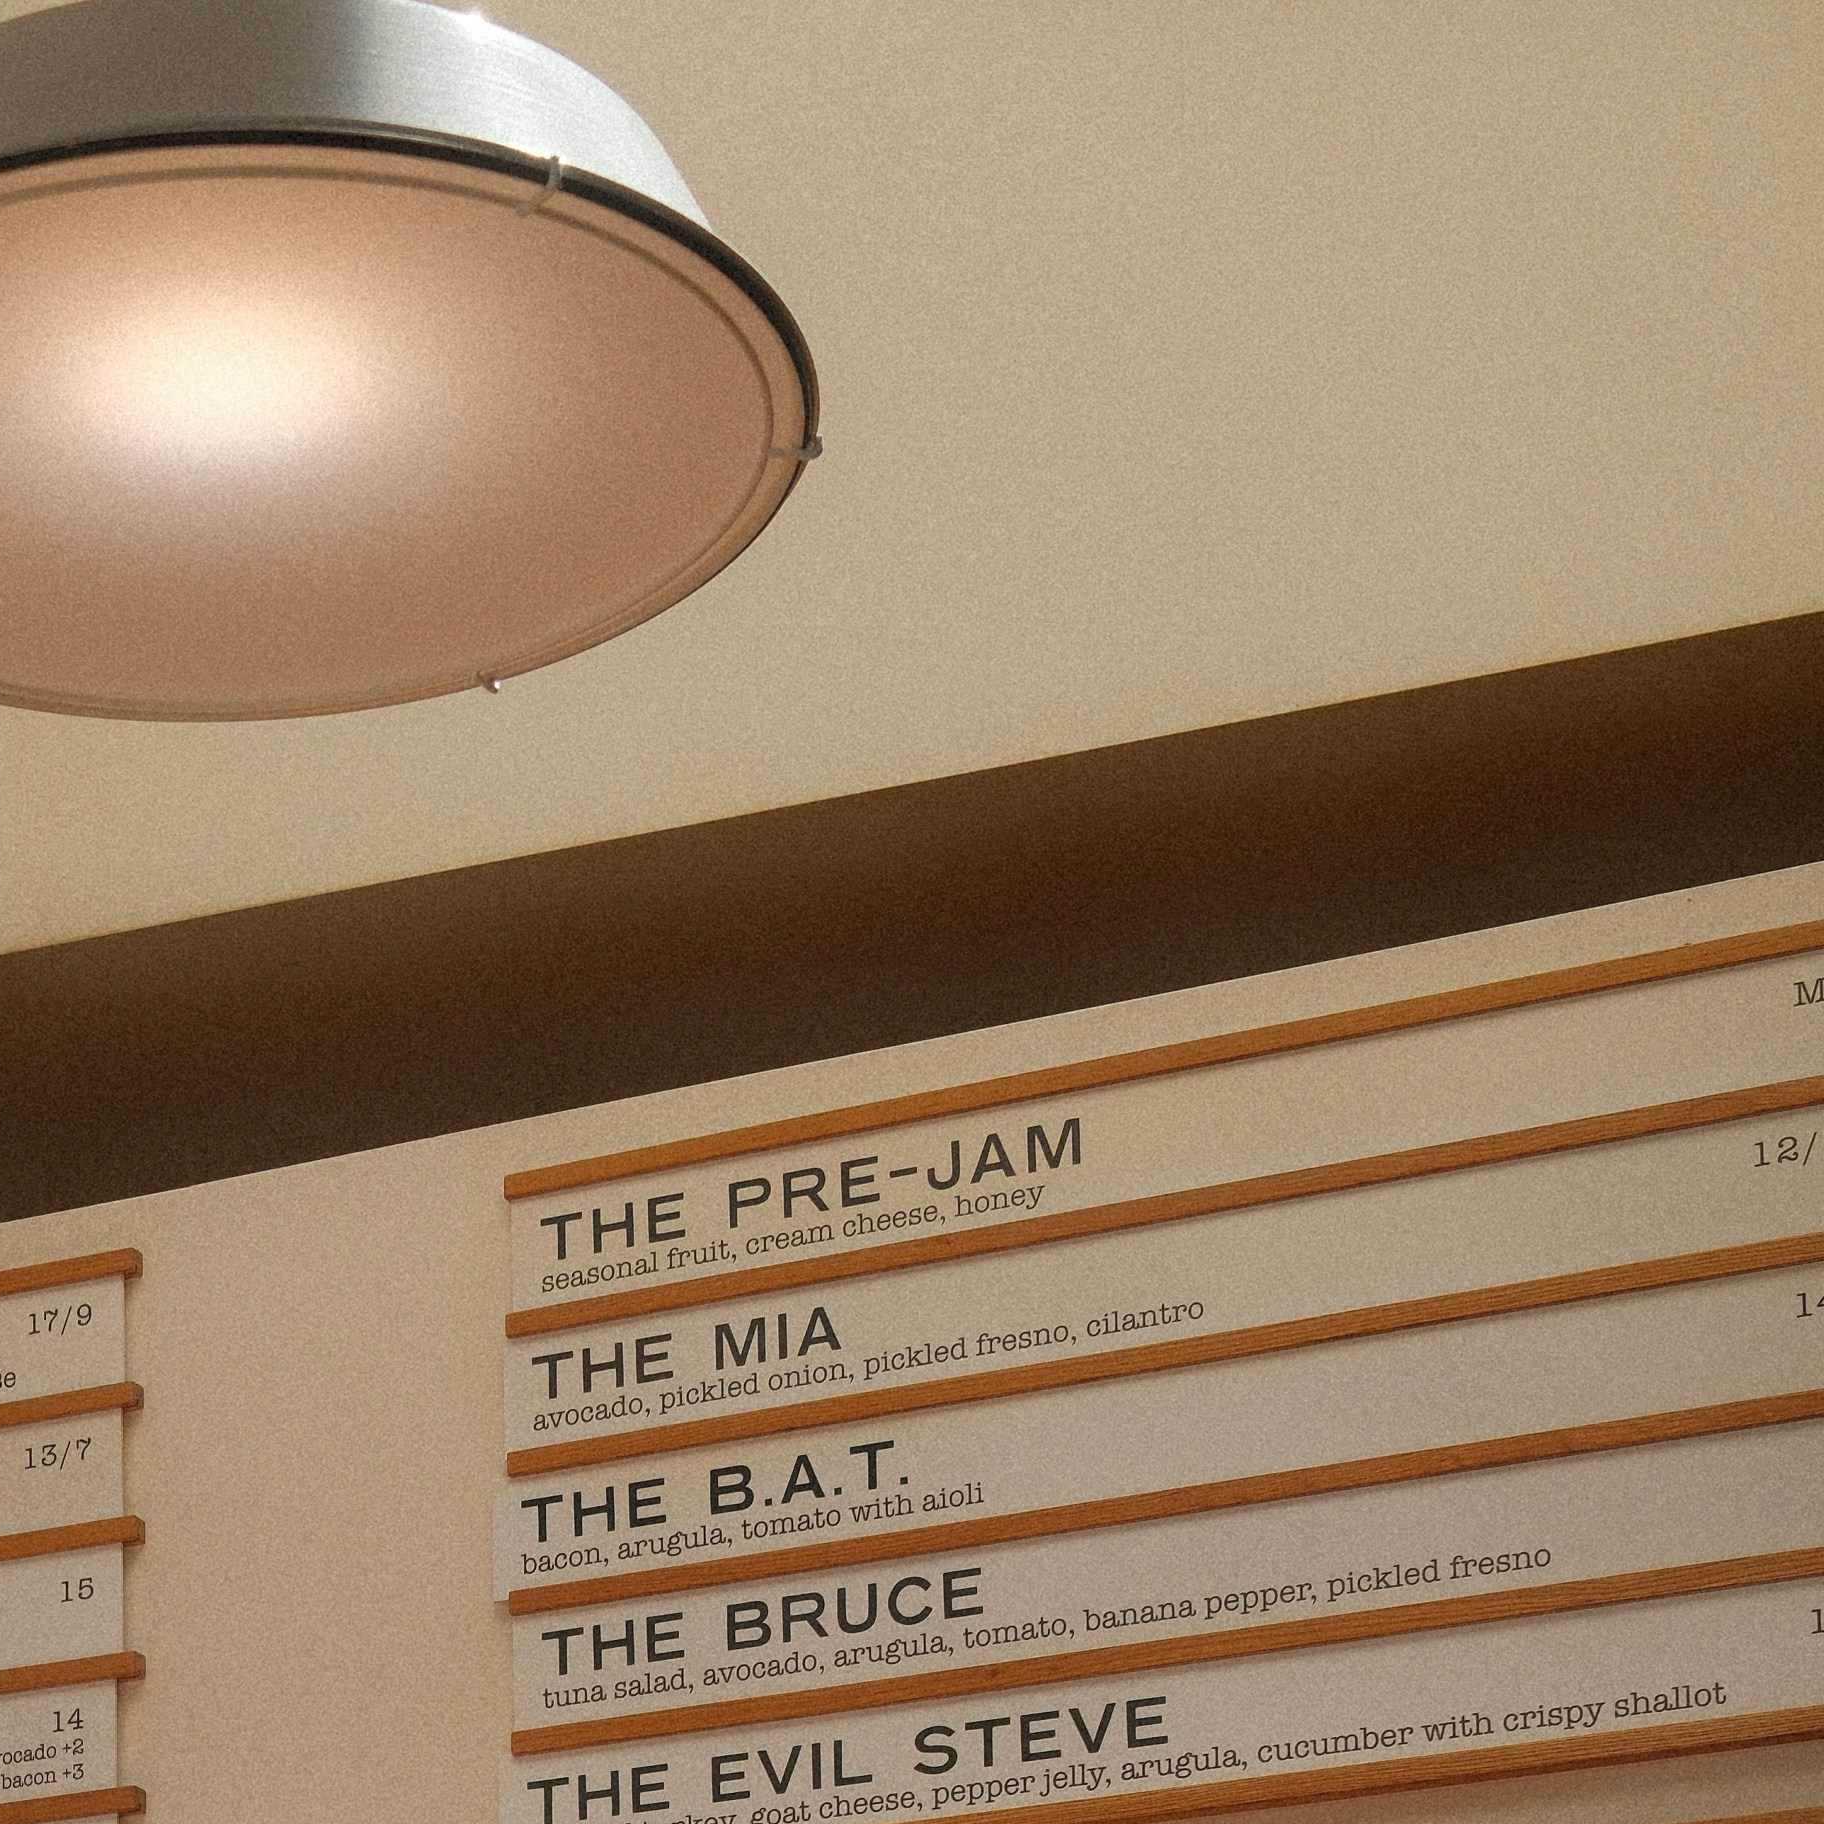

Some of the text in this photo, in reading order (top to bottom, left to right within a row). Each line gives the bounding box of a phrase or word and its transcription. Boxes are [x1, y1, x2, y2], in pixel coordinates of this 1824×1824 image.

[540, 1118, 1081, 1260] THE PRE-JAM
[542, 1186, 1044, 1292] seasonal fruit, cream cheese, honey
[30, 1304, 92, 1335] 17/9
[531, 1307, 841, 1399] THE MIA
[534, 1302, 1204, 1431] avocado, pickled onion, pickled fresno, cilantro
[26, 1438, 91, 1469] 13/7
[521, 1440, 908, 1543] THE B.A.T.
[522, 1483, 983, 1574] bacon, arugula, tomato with aioli
[63, 1577, 94, 1602] 15
[542, 1567, 983, 1676] THE BRUCE
[543, 1549, 1551, 1708] tuna salad, avocado, arugula, tomato, banana pepper, pickled fresno
[54, 1708, 83, 1732] 14
[64, 1739, 84, 1754] +2
[527, 1696, 1168, 1824] THE EVIL STEVE
[819, 1791, 922, 1819] cheese,
[933, 1776, 1035, 1810] pepper
[1040, 1764, 1111, 1796] jelly,
[1121, 1746, 1247, 1780] arugula,
[1258, 1727, 1414, 1763] cucumber
[1422, 1713, 1493, 1741] with
[1503, 1702, 1604, 1731] crispy
[1615, 1683, 1726, 1717] shallot
[2, 1763, 84, 1789] bacon +3
